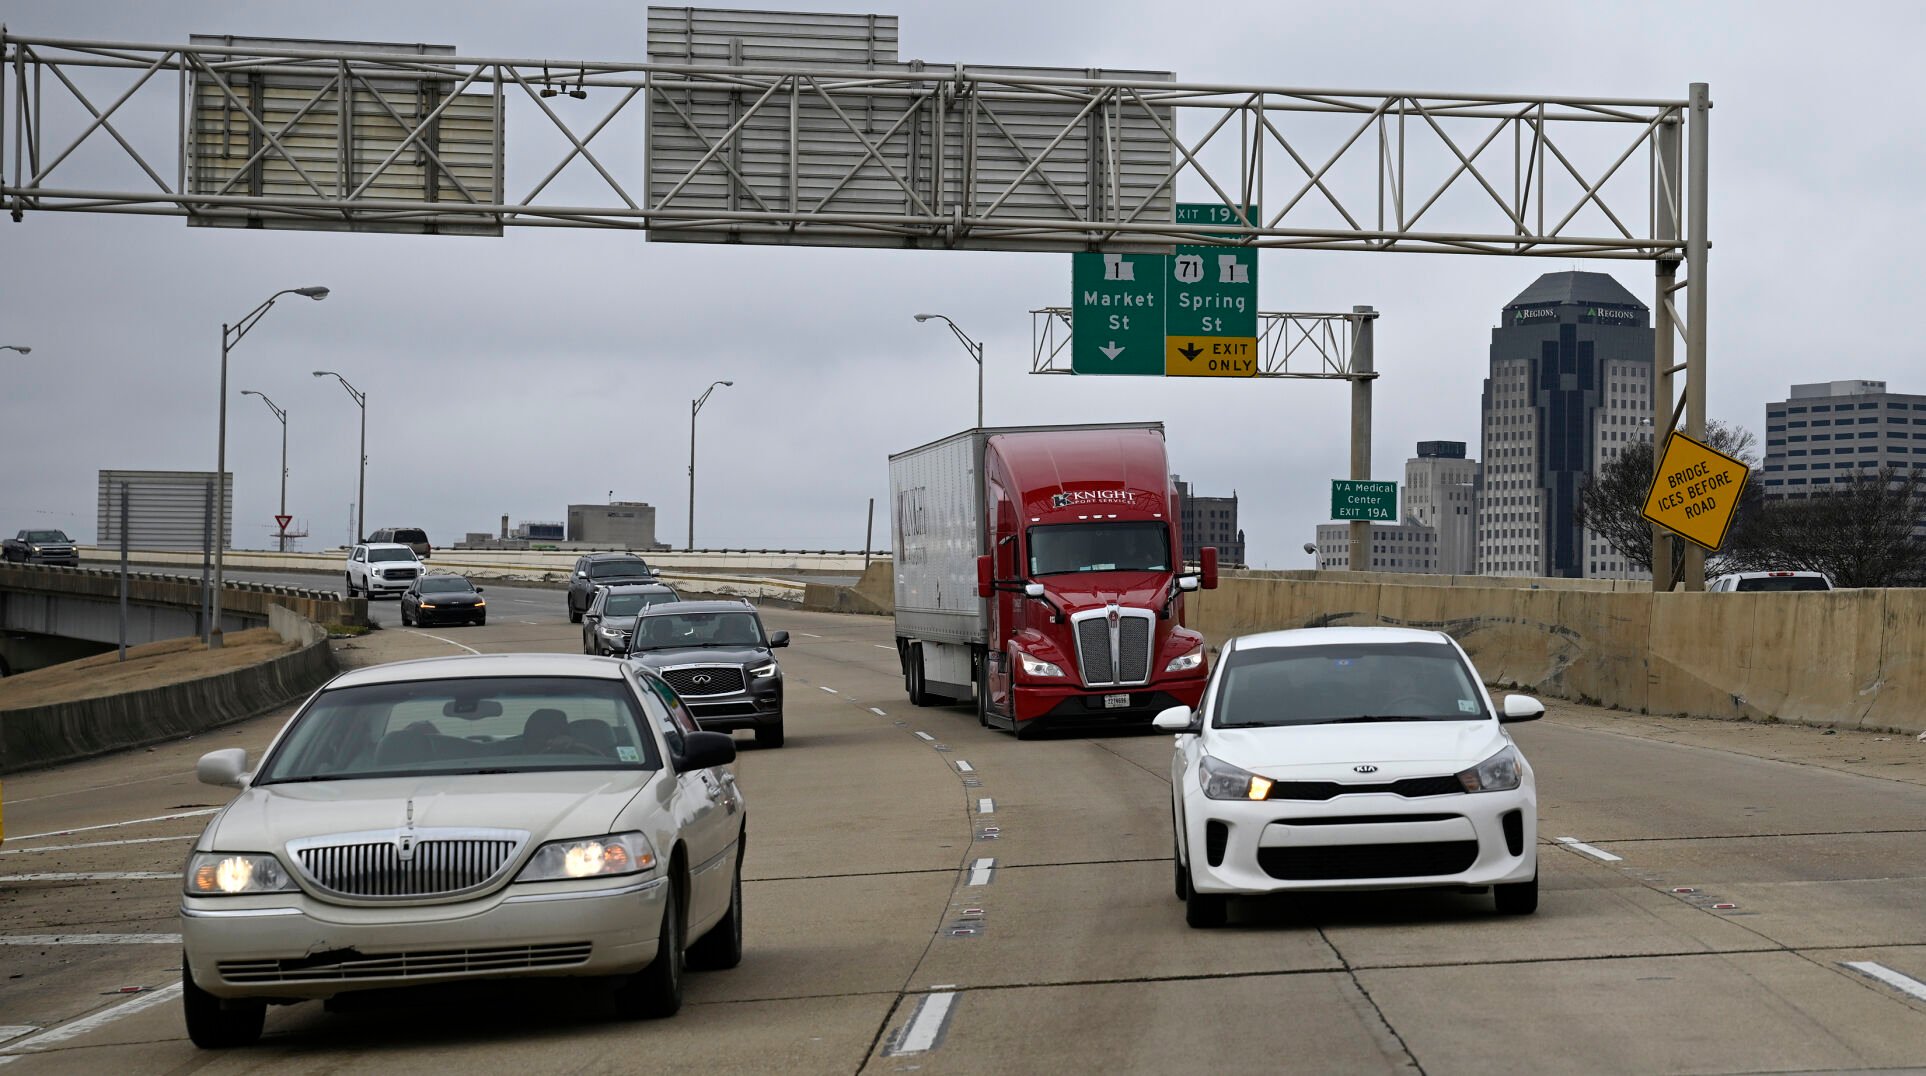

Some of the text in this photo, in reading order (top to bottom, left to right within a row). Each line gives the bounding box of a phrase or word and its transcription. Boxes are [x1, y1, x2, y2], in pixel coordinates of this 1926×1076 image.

[1177, 207, 1241, 222] XIT 19
[1114, 262, 1120, 279] 1
[1179, 260, 1198, 278] 71
[1228, 264, 1235, 281] 1
[1084, 290, 1154, 307] Market
[1179, 292, 1245, 313] Spring
[1522, 308, 1554, 319] REGIONS
[1597, 307, 1634, 319] REGIONS
[1109, 315, 1130, 330] St
[1201, 316, 1222, 332] St
[1213, 343, 1248, 355] EXIT
[1208, 359, 1252, 371] ONLY
[1667, 461, 1710, 489] BRIDGE
[1074, 490, 1136, 501] KNIGHT
[1355, 484, 1394, 493] Medical
[1658, 470, 1733, 512] ICES BEFORE
[1348, 496, 1381, 504] Center
[1685, 496, 1716, 519] ROAD
[1340, 508, 1388, 517] EXIT 19A
[1355, 765, 1377, 773] KIA
